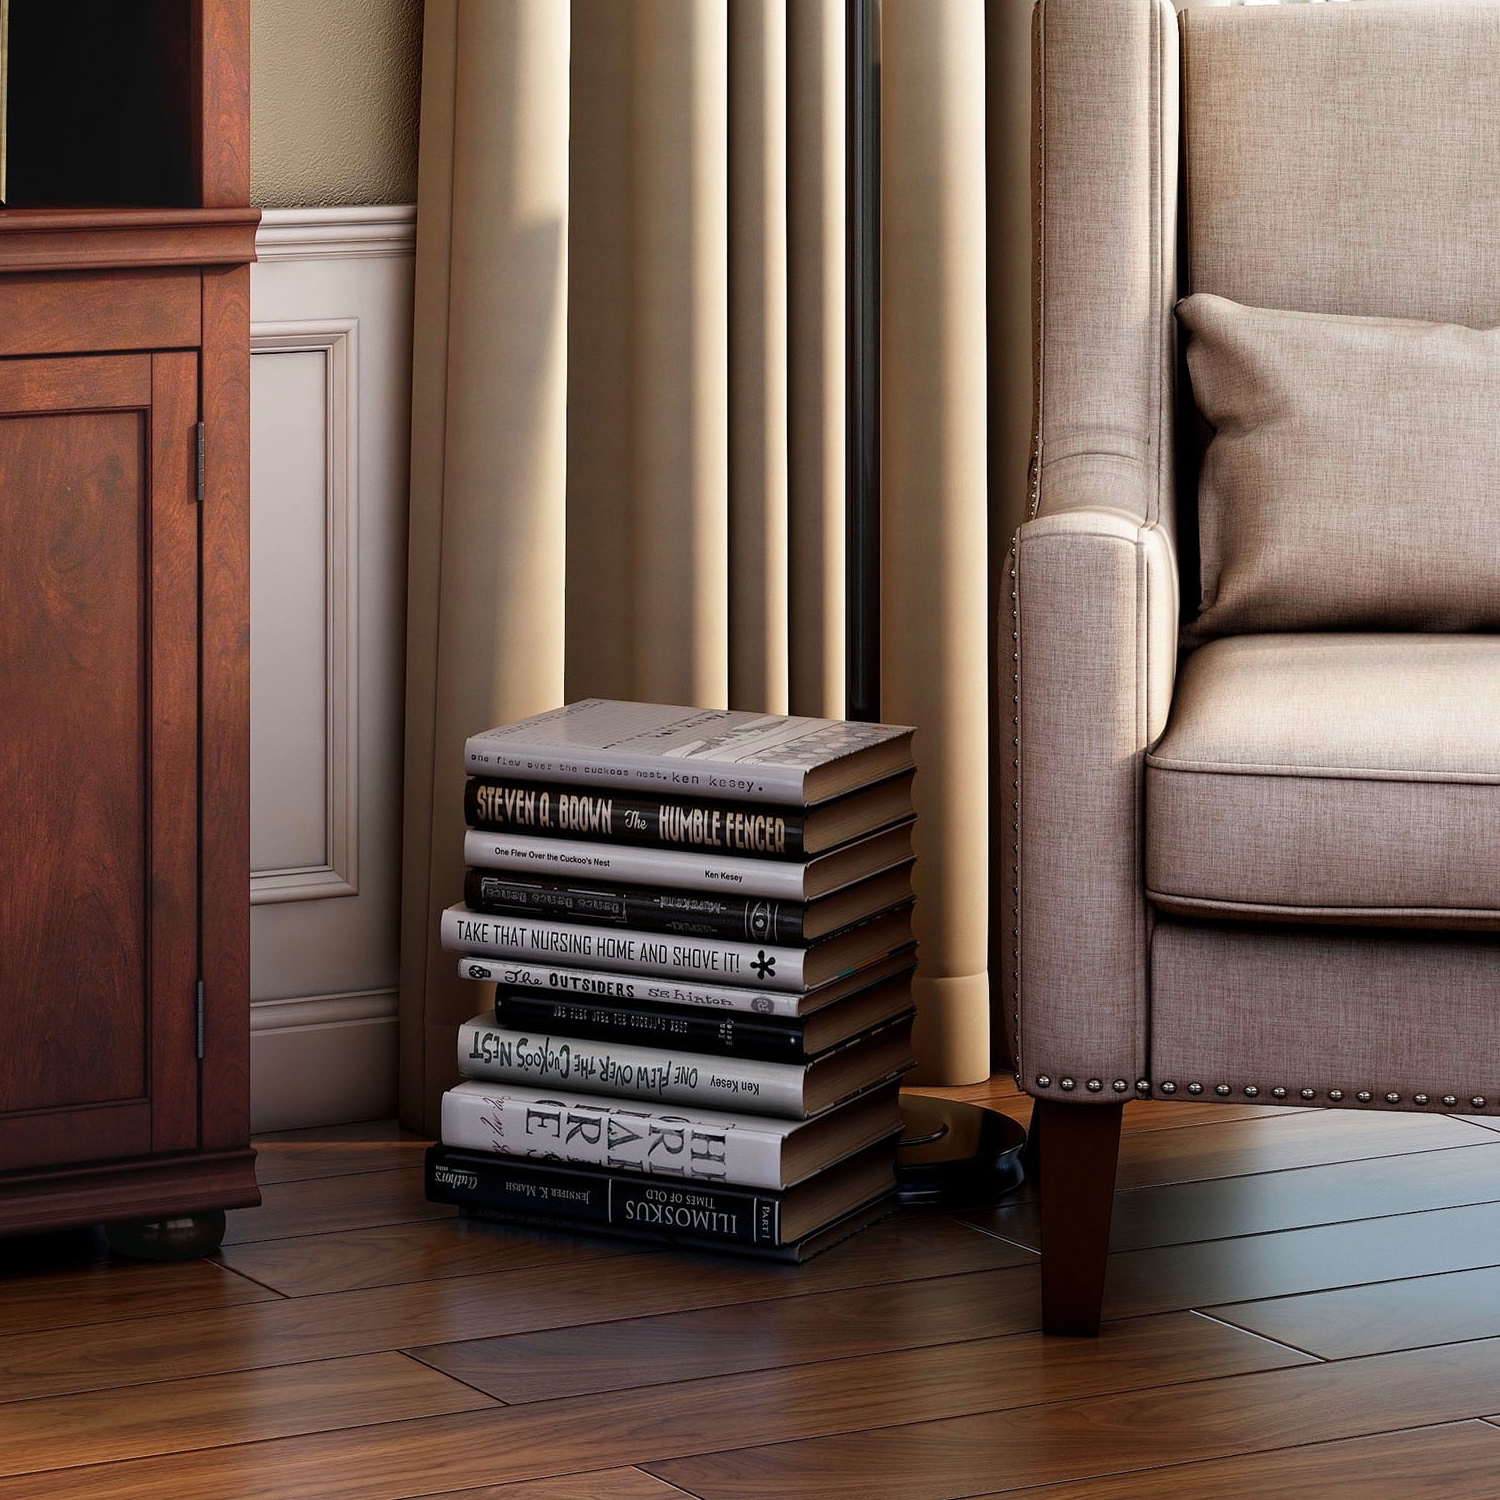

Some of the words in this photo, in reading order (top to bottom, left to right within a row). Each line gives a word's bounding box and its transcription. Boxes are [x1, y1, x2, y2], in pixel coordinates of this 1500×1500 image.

[471, 753, 490, 764] one
[496, 755, 521, 768] flew
[527, 761, 553, 771] over
[559, 763, 578, 774] the
[583, 765, 630, 778] cuckoos
[671, 770, 701, 785] ken
[476, 785, 536, 827] STEVEN
[539, 791, 555, 828] A.
[559, 794, 613, 835] BROWN
[624, 809, 648, 831] The
[659, 804, 722, 846] HUMBLE
[494, 846, 510, 858] One
[510, 847, 528, 860] Flew
[528, 849, 547, 861] Over
[546, 851, 559, 862] the
[560, 853, 593, 867] Cuckoo's
[594, 857, 611, 868] Nest
[704, 870, 719, 880] Ken
[720, 871, 743, 883] Kesey
[457, 920, 489, 943] TAKE
[493, 924, 527, 948] THAT
[531, 929, 593, 956] NURSING
[596, 937, 635, 961] HOME
[639, 943, 668, 964] AND
[672, 946, 720, 971] SHOVE
[723, 952, 741, 973] IT!
[504, 969, 543, 987] The
[549, 972, 635, 998] OUTSIDERS
[671, 989, 735, 1007] hinton
[468, 1030, 513, 1064] NEST
[573, 1053, 597, 1081] THE
[598, 1055, 634, 1087] OVER
[636, 1060, 672, 1096] FLEW
[674, 1065, 699, 1089] ONE
[710, 1073, 740, 1093] Kesey
[741, 1079, 761, 1096] Ken
[504, 1181, 537, 1198] MARSH
[551, 1187, 591, 1205] JENNIFER
[645, 1188, 668, 1201] OLD
[669, 1191, 683, 1203] OF
[685, 1192, 717, 1210] TIMES
[624, 1199, 738, 1235] ILIMOSKUS
[762, 1206, 771, 1233] PART
